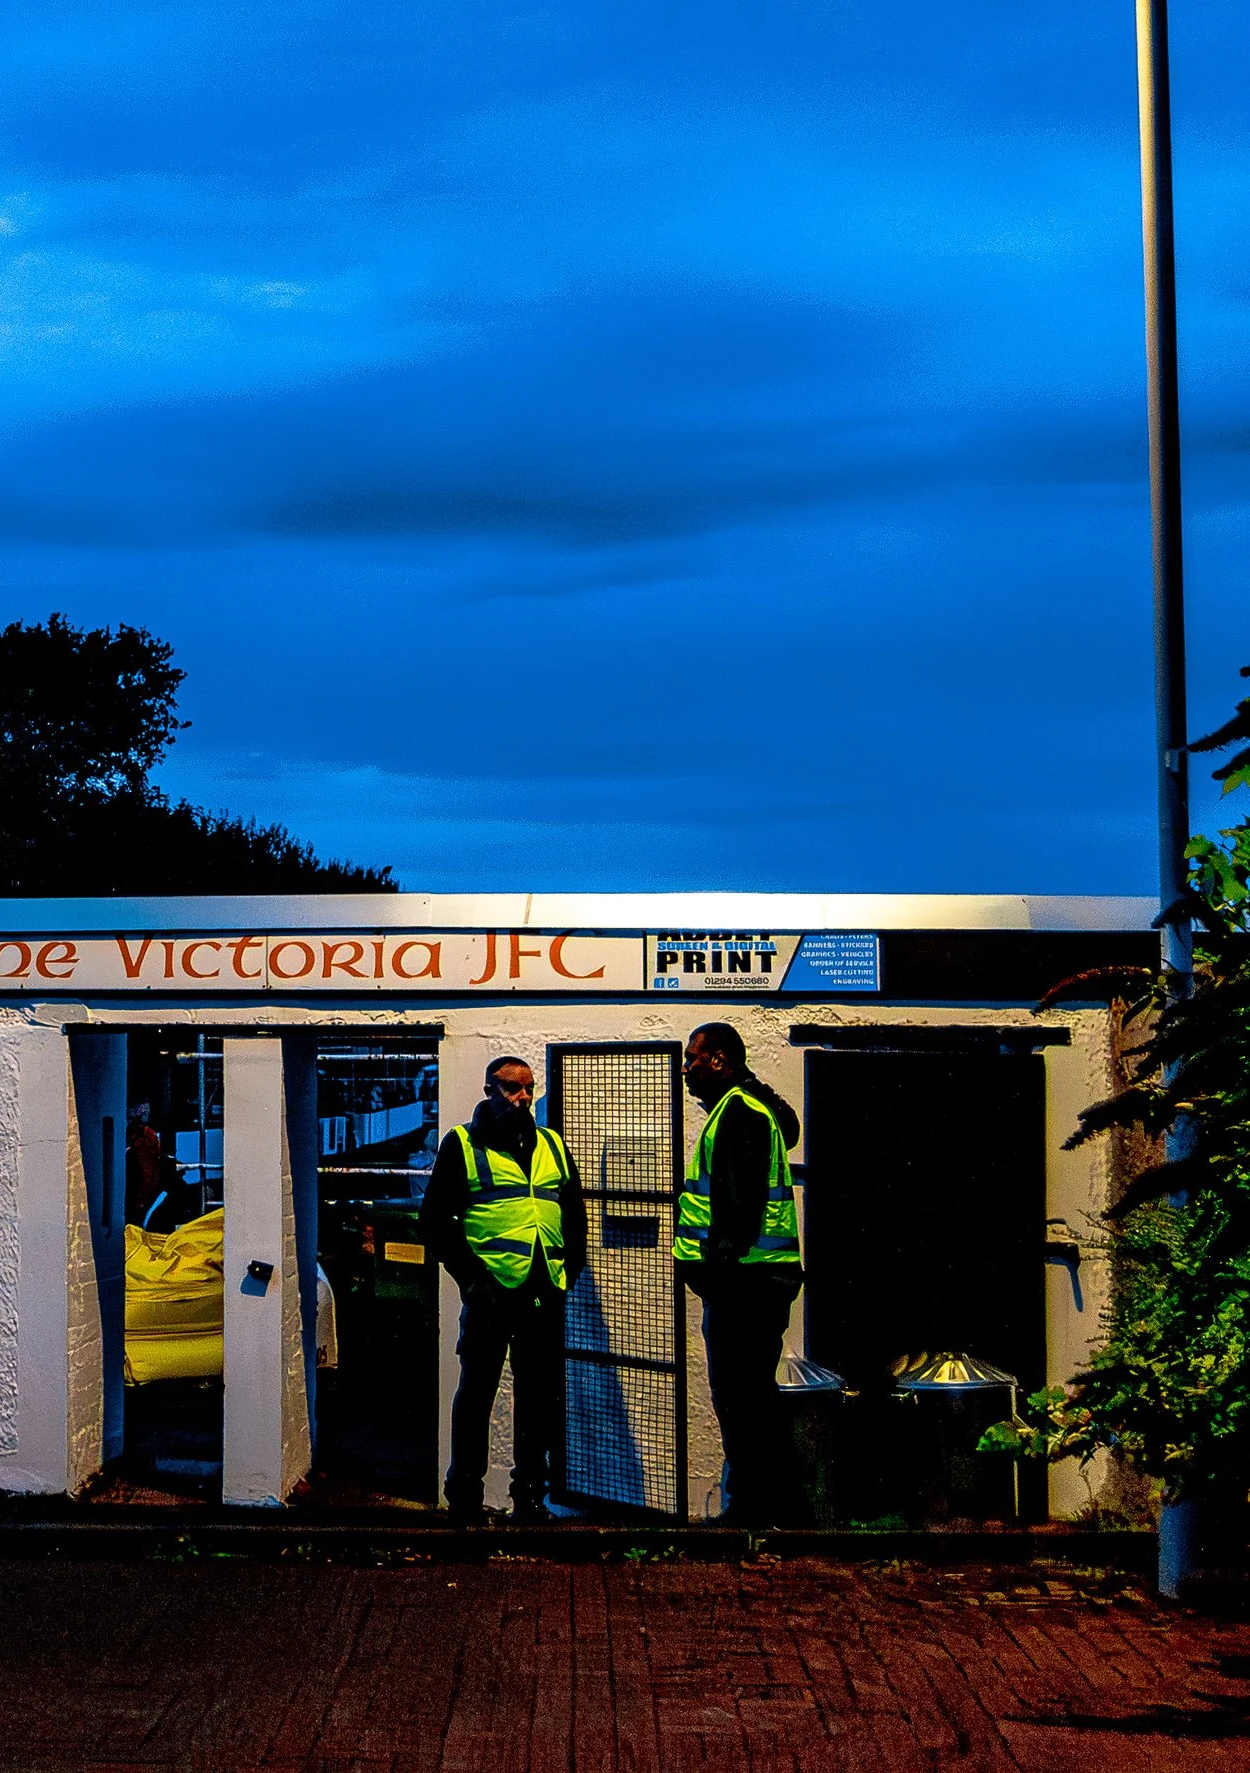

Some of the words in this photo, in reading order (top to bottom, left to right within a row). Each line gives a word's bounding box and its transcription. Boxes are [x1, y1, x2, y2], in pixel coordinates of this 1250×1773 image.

[113, 932, 442, 979] Victoria
[469, 930, 607, 985] JFC
[656, 951, 777, 973] PRINT
